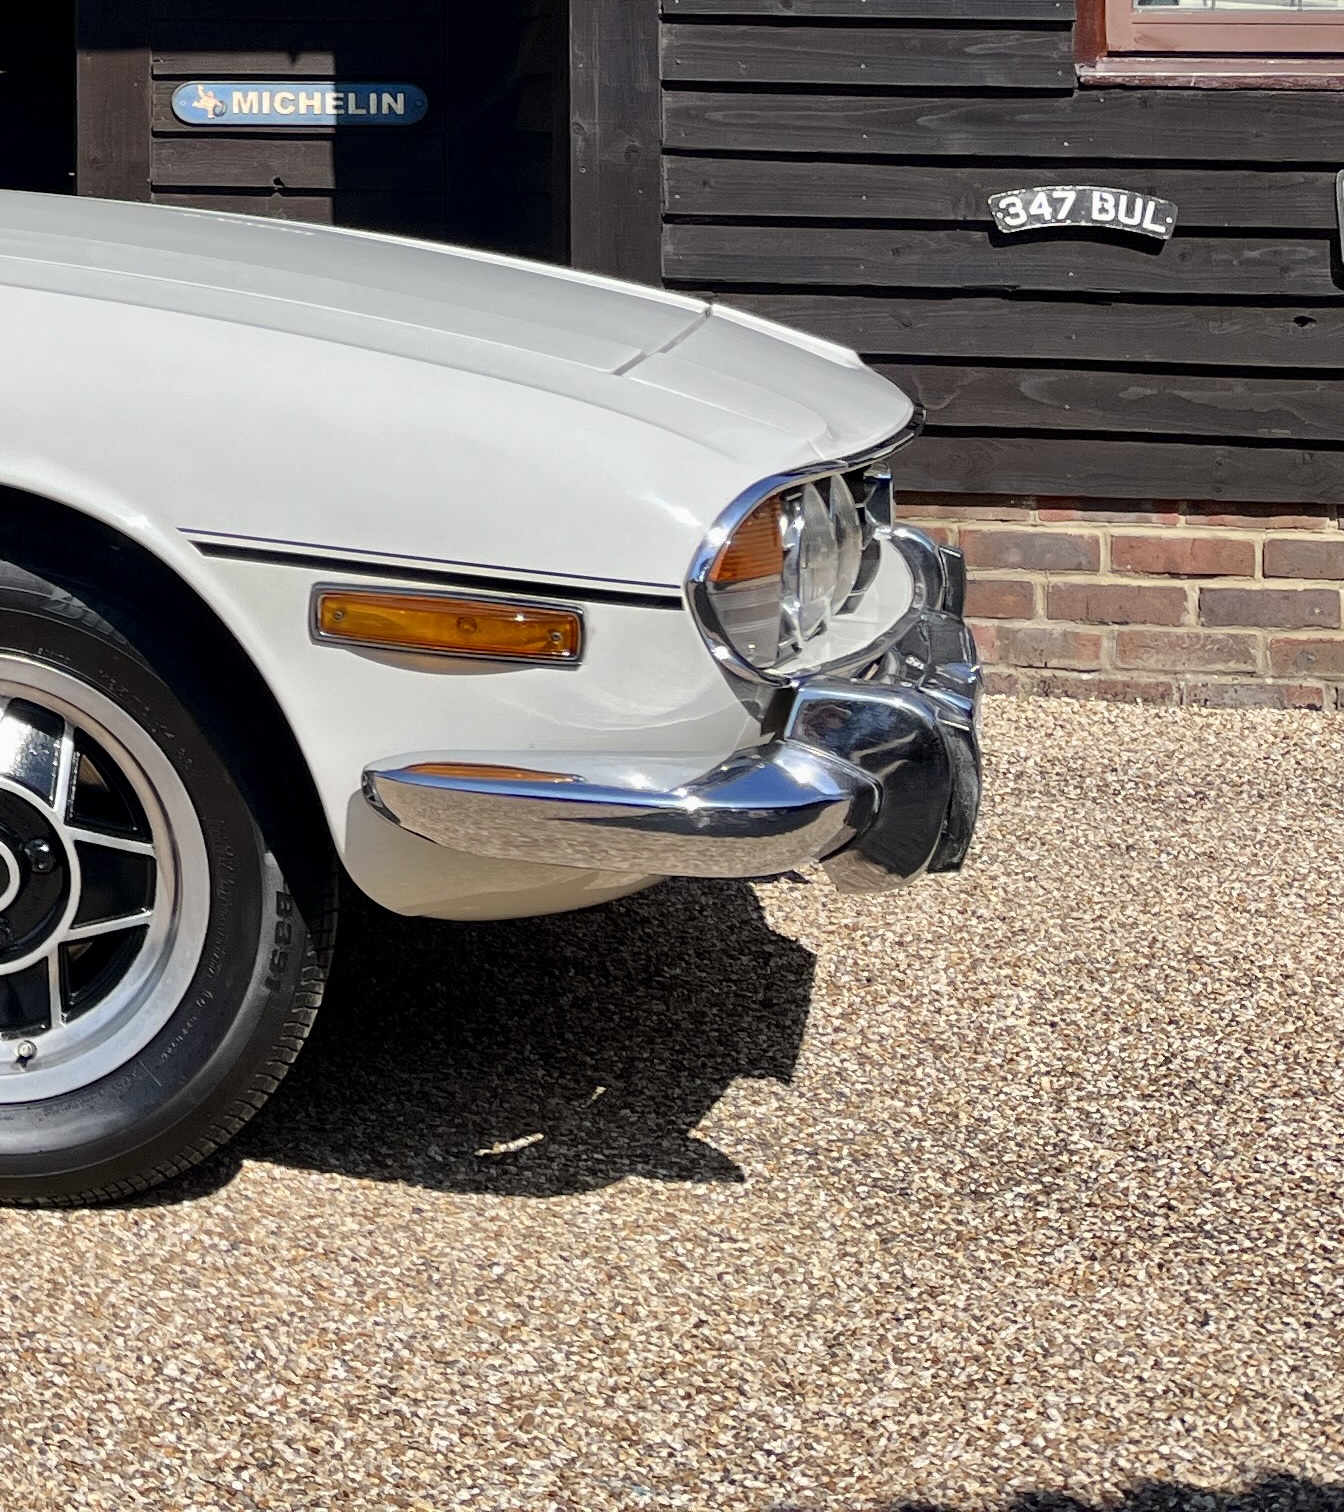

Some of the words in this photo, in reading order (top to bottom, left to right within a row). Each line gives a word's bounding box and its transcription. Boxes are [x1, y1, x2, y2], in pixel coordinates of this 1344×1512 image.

[232, 91, 405, 116] MICHELIN
[998, 190, 1076, 226] 347
[1091, 191, 1166, 233] BUL
